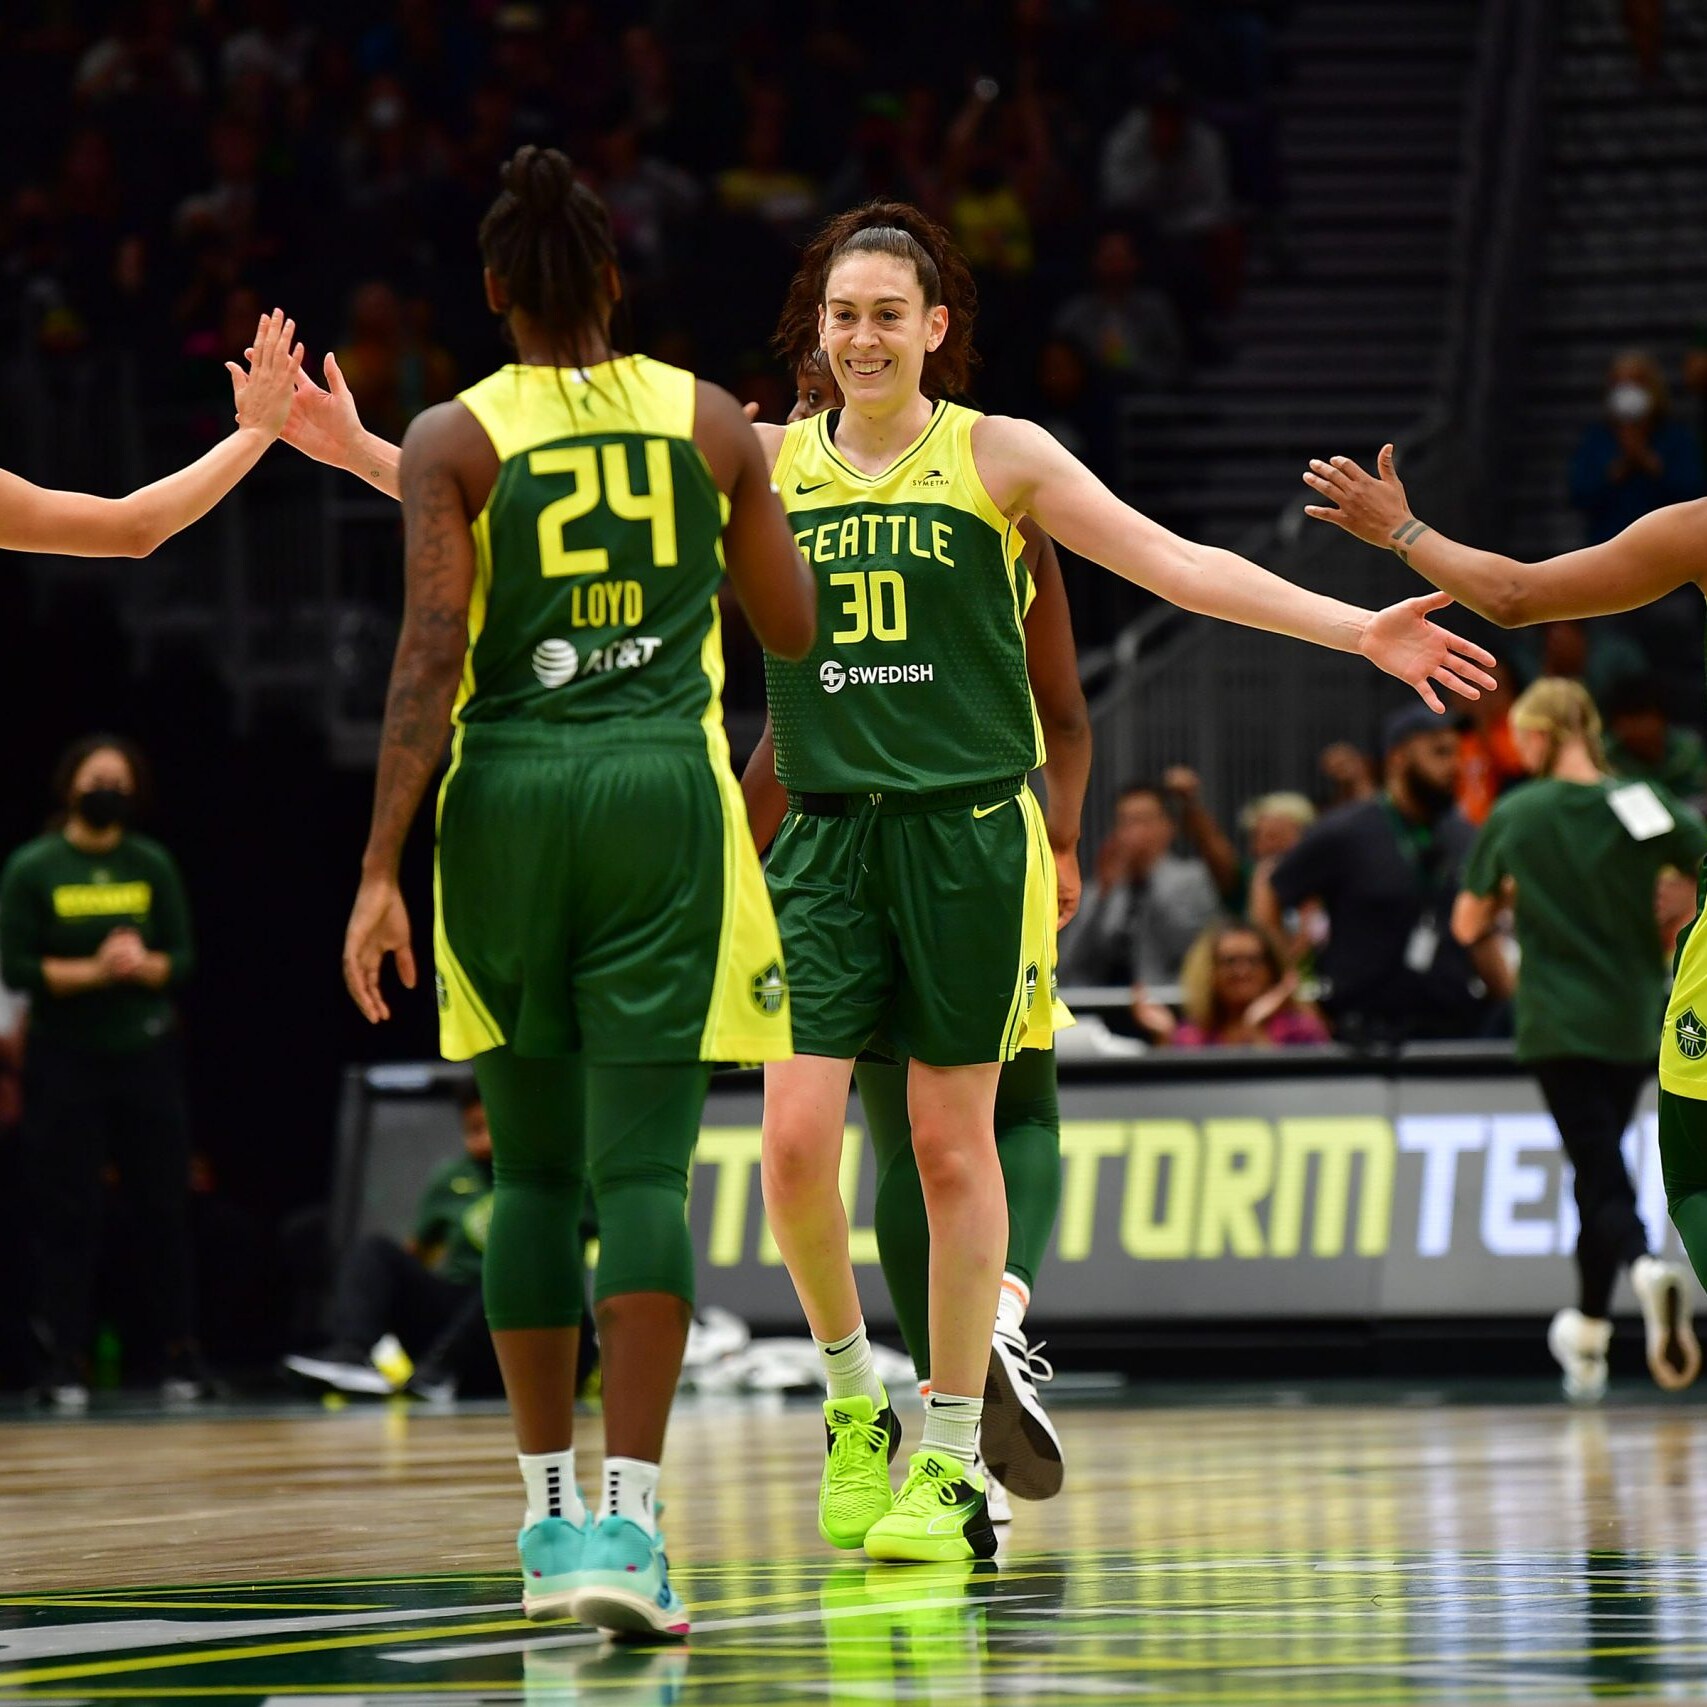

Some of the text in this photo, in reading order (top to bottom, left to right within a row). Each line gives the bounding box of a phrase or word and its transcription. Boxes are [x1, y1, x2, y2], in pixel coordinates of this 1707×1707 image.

[528, 439, 678, 578] 24
[912, 479, 949, 487] SYMETRA
[571, 581, 643, 628] LOYD
[829, 570, 907, 644] 30
[849, 664, 934, 684] SWEDISH
[1057, 1116, 1394, 1261] TORM
